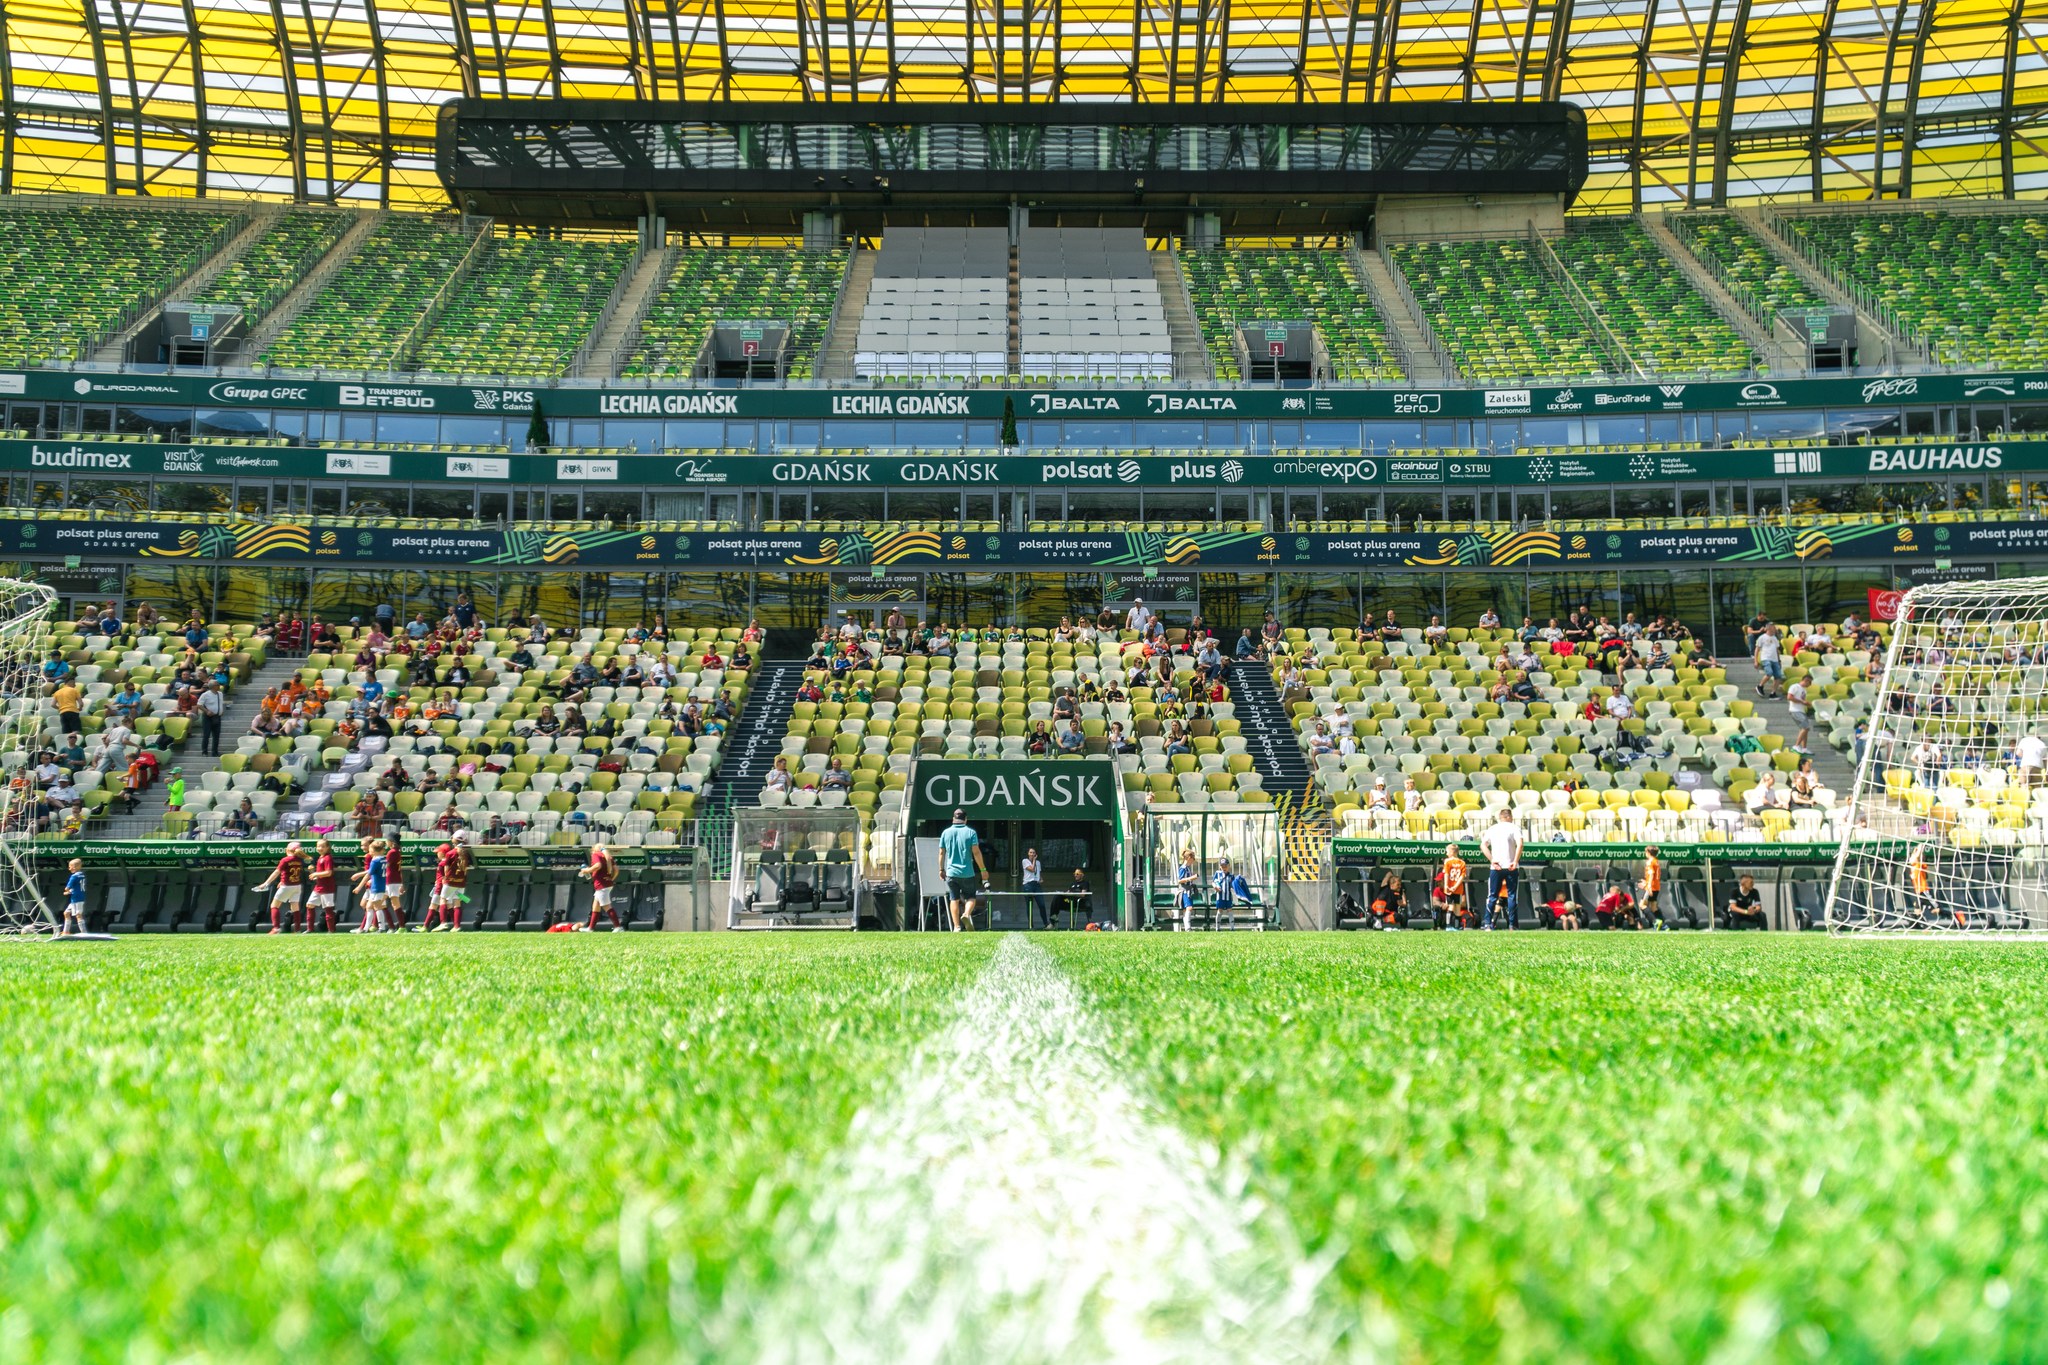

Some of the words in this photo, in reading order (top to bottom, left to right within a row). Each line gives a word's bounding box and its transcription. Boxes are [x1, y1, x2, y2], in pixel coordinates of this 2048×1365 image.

[93, 384, 178, 392] EURODARMAL
[224, 386, 268, 400] Grupa
[272, 388, 307, 399] GPEC
[367, 388, 423, 397] TRANSPORT
[340, 386, 434, 407] BET-BUD
[503, 391, 533, 402] PKS
[600, 396, 661, 413] LECHIA
[664, 392, 737, 413] GDAŃSK
[1394, 394, 1418, 404] pre
[1490, 394, 1526, 402] Zaleski
[1607, 394, 1650, 403] EuroTrade
[833, 396, 893, 414] LECHIA
[896, 393, 969, 414] GDAŃSK
[1052, 398, 1120, 409] BALTA
[1170, 398, 1236, 409] BALTA
[32, 446, 131, 468] budimex
[164, 452, 188, 461] VISIT
[1799, 452, 1821, 472] NDI
[1869, 447, 2002, 471] BAUHAUS
[164, 461, 202, 471] GDANSK
[773, 460, 870, 481] GDAŃSK
[901, 460, 999, 480] GDAŃSK
[1043, 461, 1112, 481] polsat
[1171, 461, 1216, 482] plus
[57, 528, 94, 538] polsat
[97, 530, 122, 540] plus
[1970, 529, 2006, 540] polsat
[2010, 528, 2034, 541] plus
[392, 537, 428, 546] polsat
[431, 538, 454, 547] plus
[708, 540, 742, 550] polsat
[745, 540, 768, 550] plus
[1019, 540, 1052, 550] polsat
[1056, 540, 1078, 550] plus
[1328, 540, 1362, 550] polsat
[1365, 540, 1386, 550] plus
[1641, 537, 1676, 548] polsat
[1679, 536, 1702, 547] plus
[1236, 669, 1252, 702] arena
[738, 734, 760, 776] polsat
[754, 705, 772, 730] plus
[766, 669, 785, 702] arena
[1248, 705, 1268, 730] plus
[1258, 734, 1284, 776] polsat
[926, 768, 1102, 805] GDAŃSK
